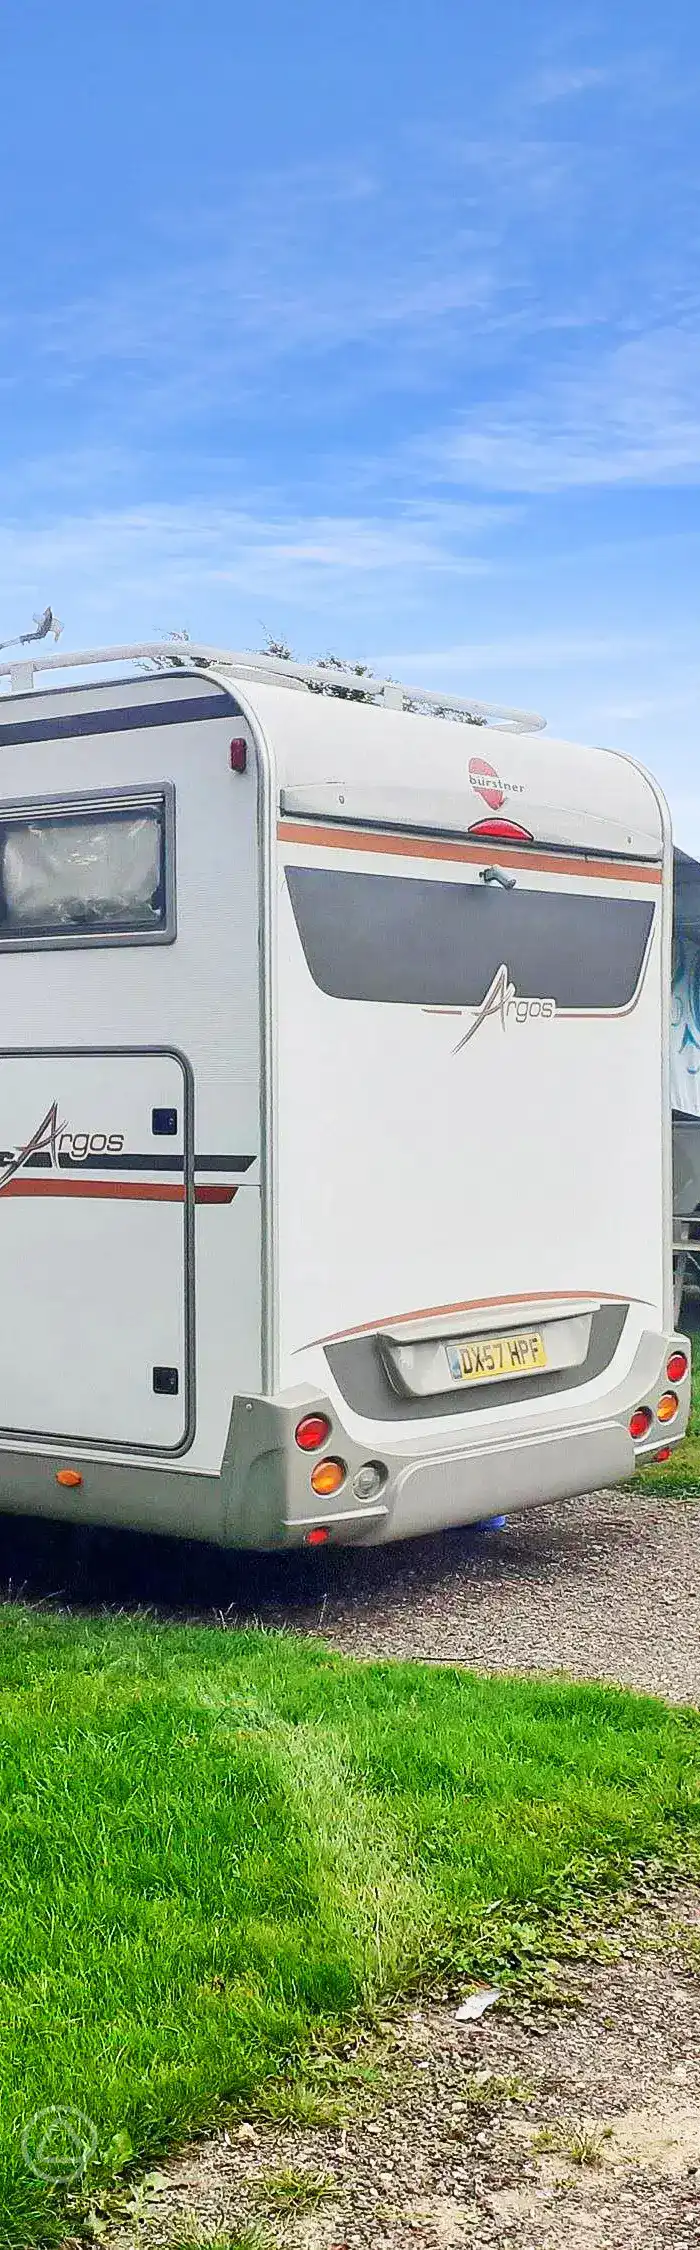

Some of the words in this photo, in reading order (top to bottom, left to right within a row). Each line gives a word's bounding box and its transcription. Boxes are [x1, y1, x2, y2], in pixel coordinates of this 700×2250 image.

[451, 970, 553, 1055] Argos
[0, 1100, 125, 1185] Argos
[460, 1344, 503, 1374] DX57
[507, 1337, 538, 1367] HPF
